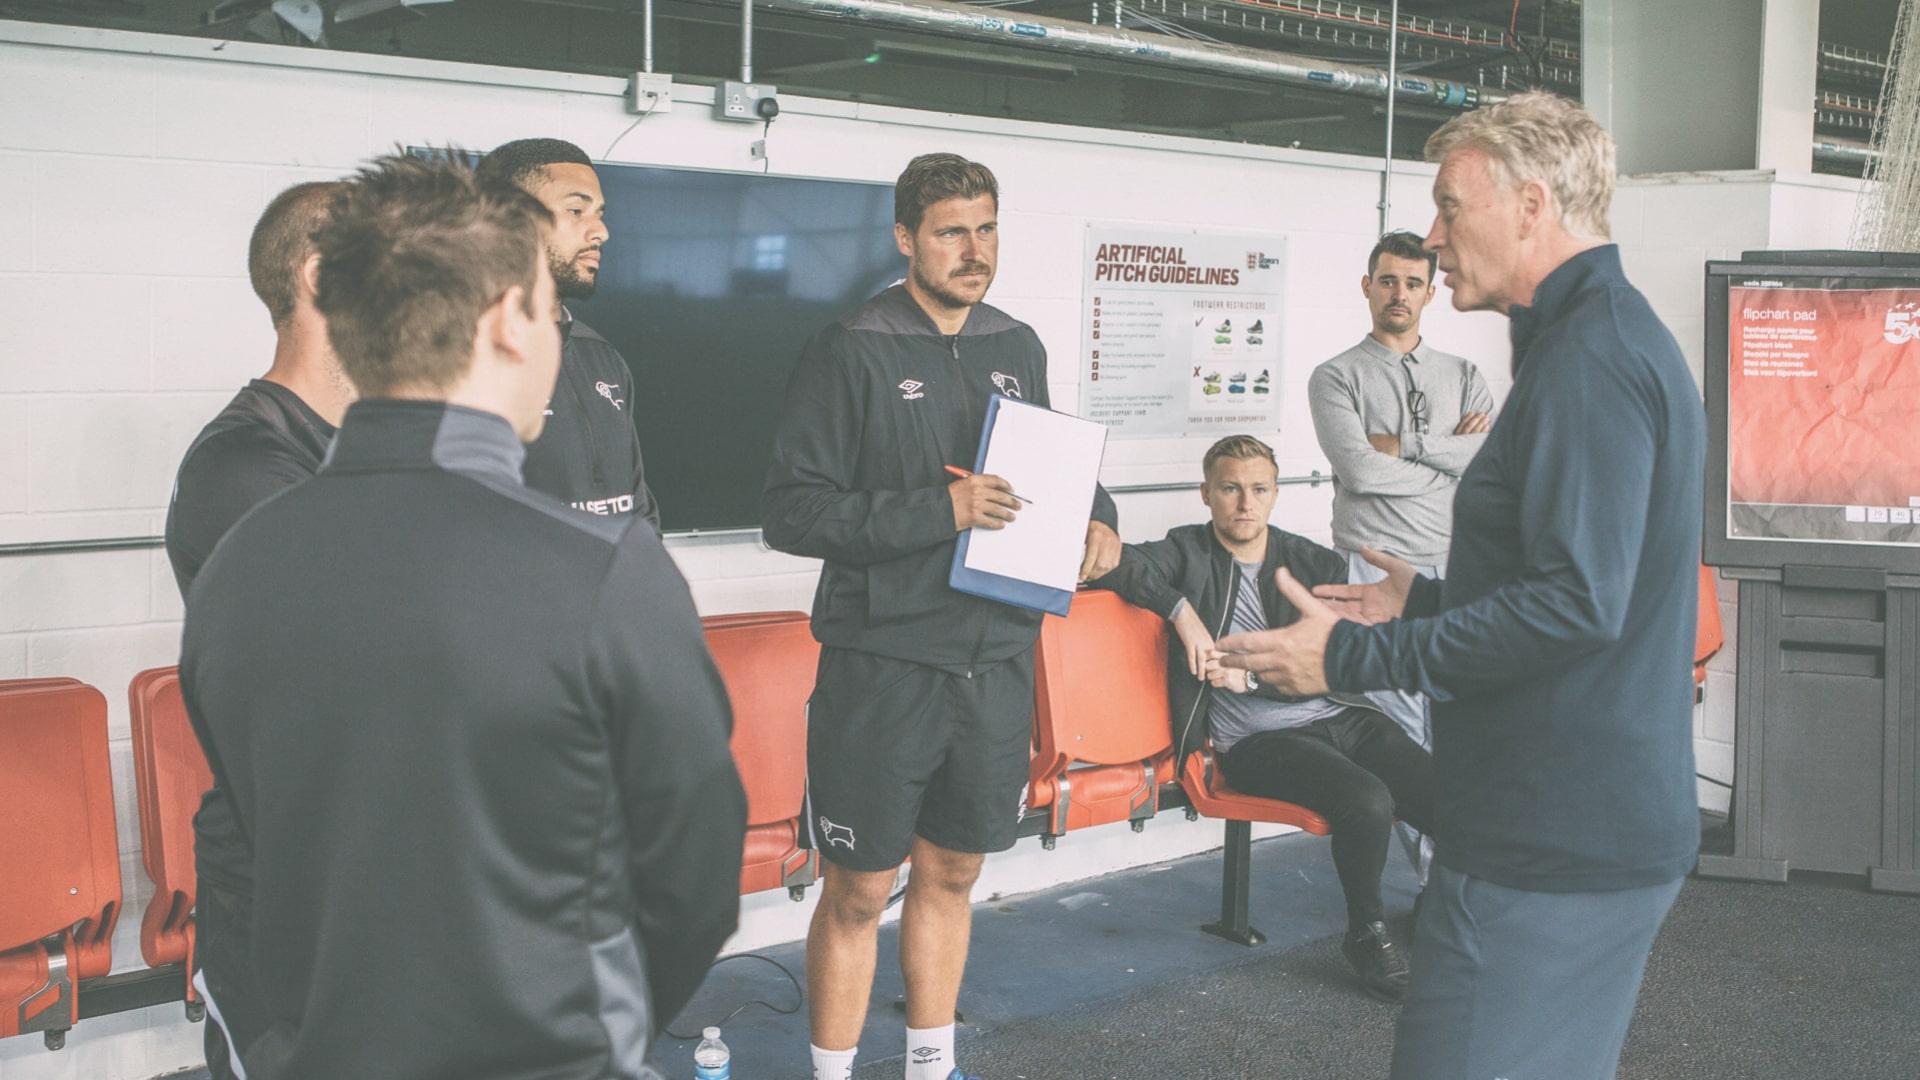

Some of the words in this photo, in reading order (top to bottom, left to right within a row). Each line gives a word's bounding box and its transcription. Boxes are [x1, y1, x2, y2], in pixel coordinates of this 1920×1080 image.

[1095, 243, 1187, 265] ARTIFICIAL
[1095, 263, 1147, 282] PITCH
[1149, 266, 1240, 286] GUIDELINES
[1743, 308, 1790, 321] flipchart
[1793, 309, 1817, 322] pad
